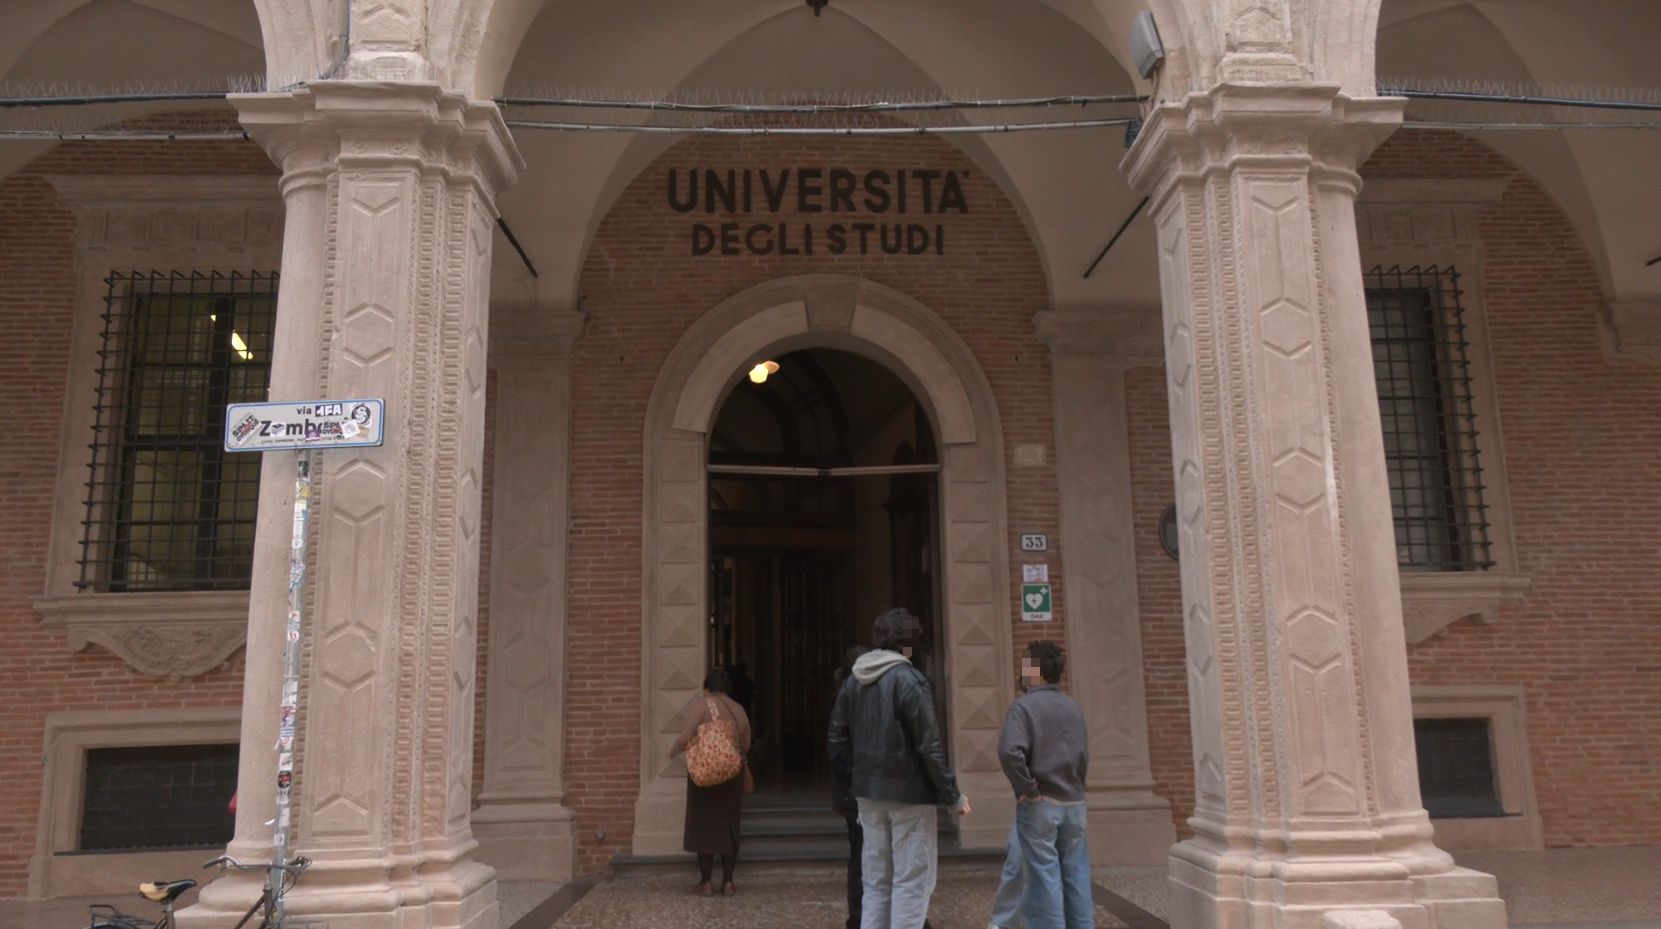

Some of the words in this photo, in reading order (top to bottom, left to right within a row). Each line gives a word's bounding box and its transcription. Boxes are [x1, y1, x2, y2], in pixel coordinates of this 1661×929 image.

[692, 223, 813, 256] DEGLI
[827, 223, 944, 256] STUDI
[297, 406, 313, 415] via
[1025, 536, 1043, 549] 33
